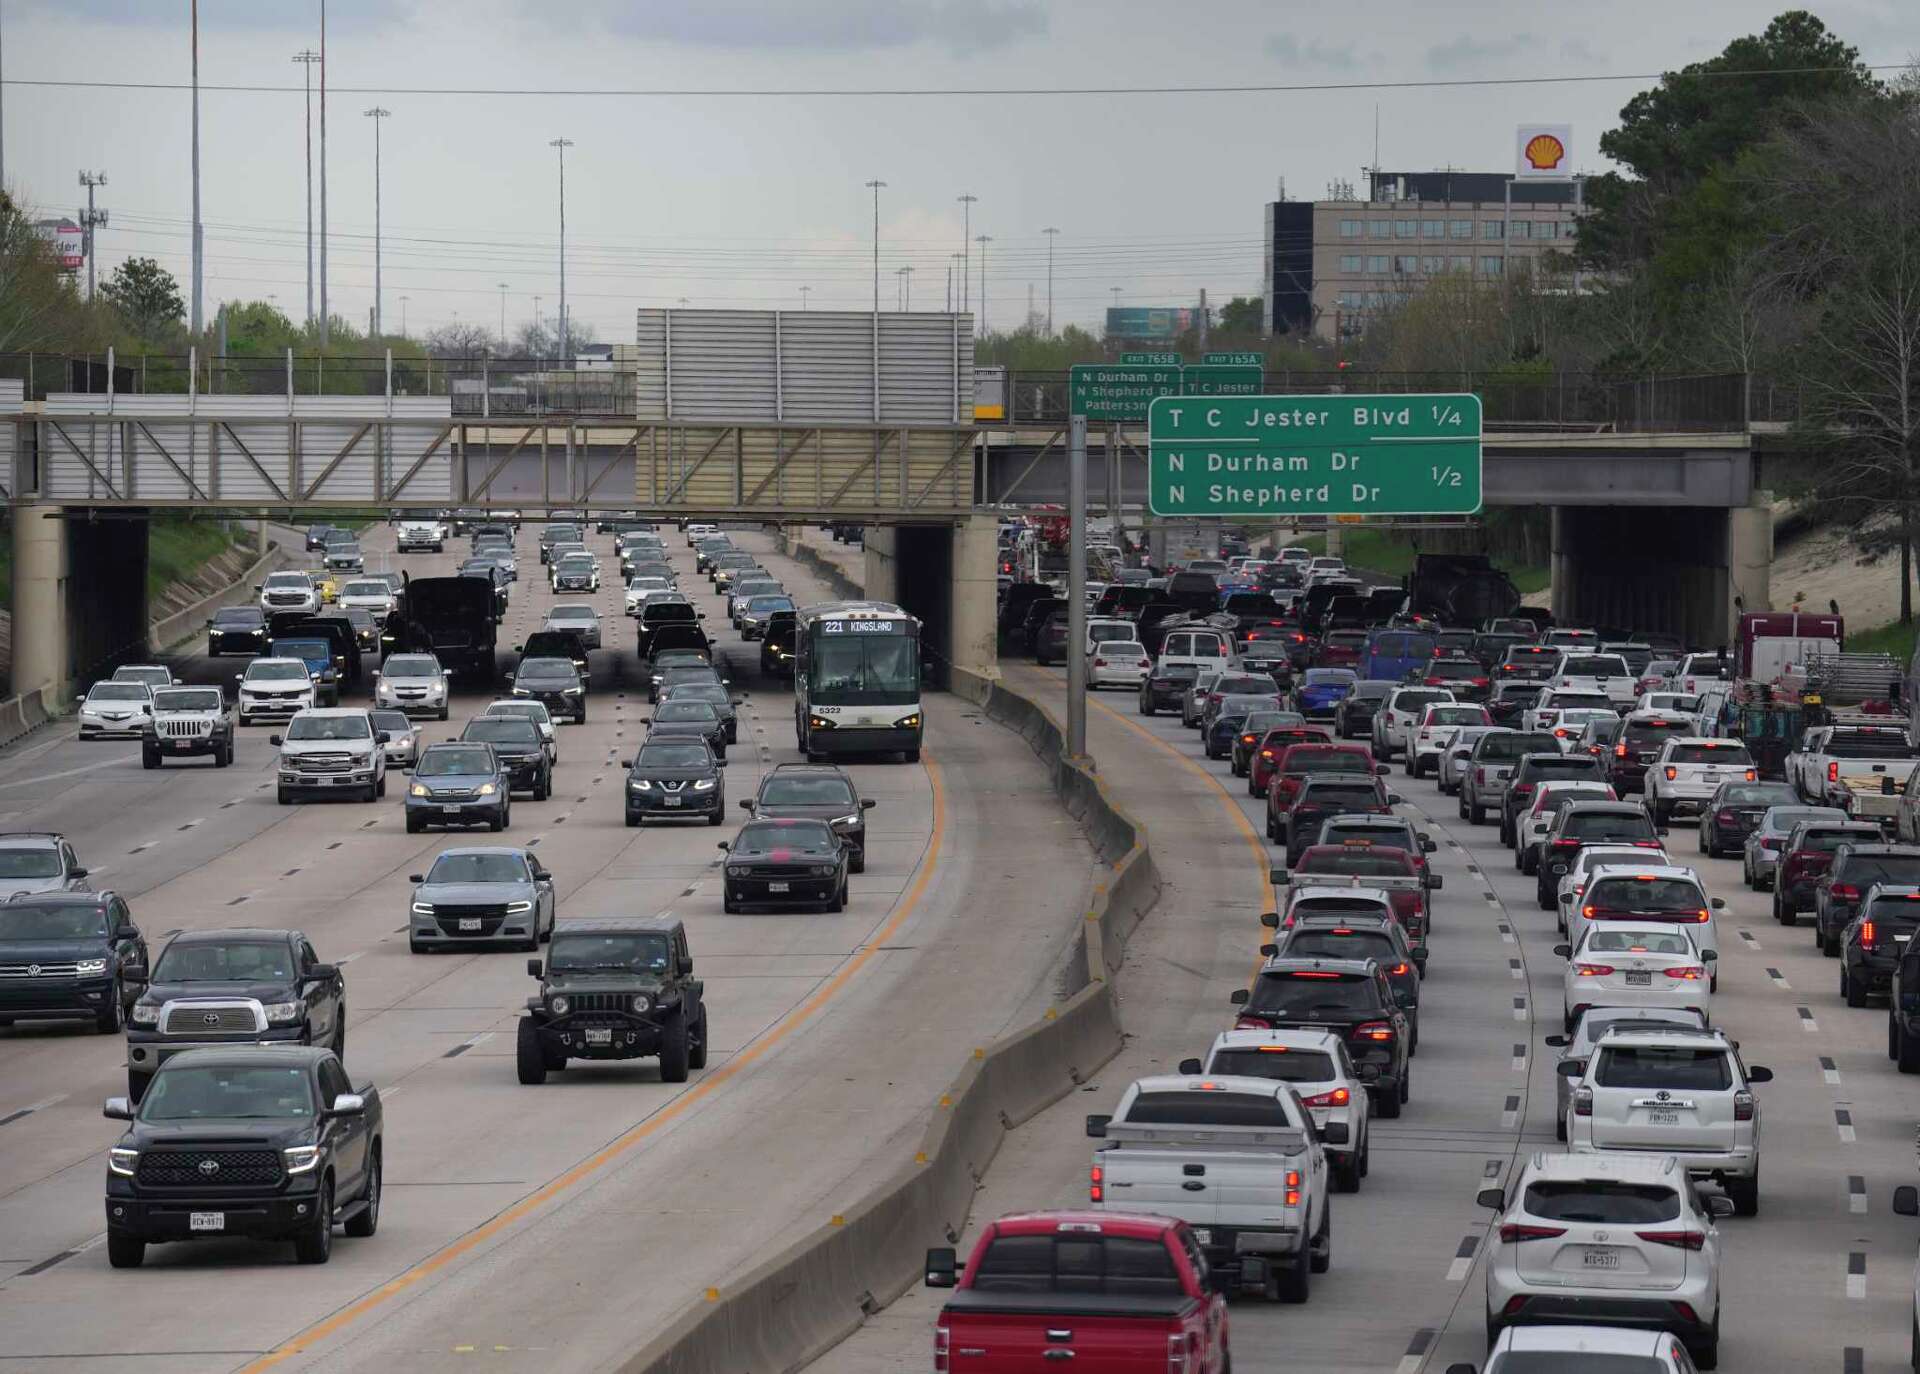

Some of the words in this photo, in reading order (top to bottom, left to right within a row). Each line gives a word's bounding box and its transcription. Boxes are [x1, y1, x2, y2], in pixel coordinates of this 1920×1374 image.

[1148, 354, 1175, 363] 765B
[1082, 373, 1092, 381] N
[1097, 372, 1148, 382] Durham
[1154, 373, 1169, 382] Dr
[1077, 386, 1086, 396] N
[1091, 386, 1153, 398] Shepherd
[1160, 387, 1174, 395] Dr
[1202, 383, 1210, 393] C
[1216, 384, 1255, 393] Jester
[1085, 401, 1147, 411] Patterson
[1169, 409, 1183, 427] T
[1206, 409, 1221, 427] C
[1245, 408, 1329, 426] Jester
[1353, 407, 1410, 426] Blvd
[1432, 405, 1462, 427] 1/4
[1169, 453, 1184, 472] N
[1208, 453, 1308, 472] Durham
[1331, 452, 1360, 471] Dr
[1431, 465, 1462, 487] 1/2
[1169, 485, 1185, 504] N
[1208, 484, 1329, 507] Shepherd
[1352, 483, 1380, 502] Dr
[825, 621, 843, 633] 221
[850, 621, 892, 632] KINGSLAND
